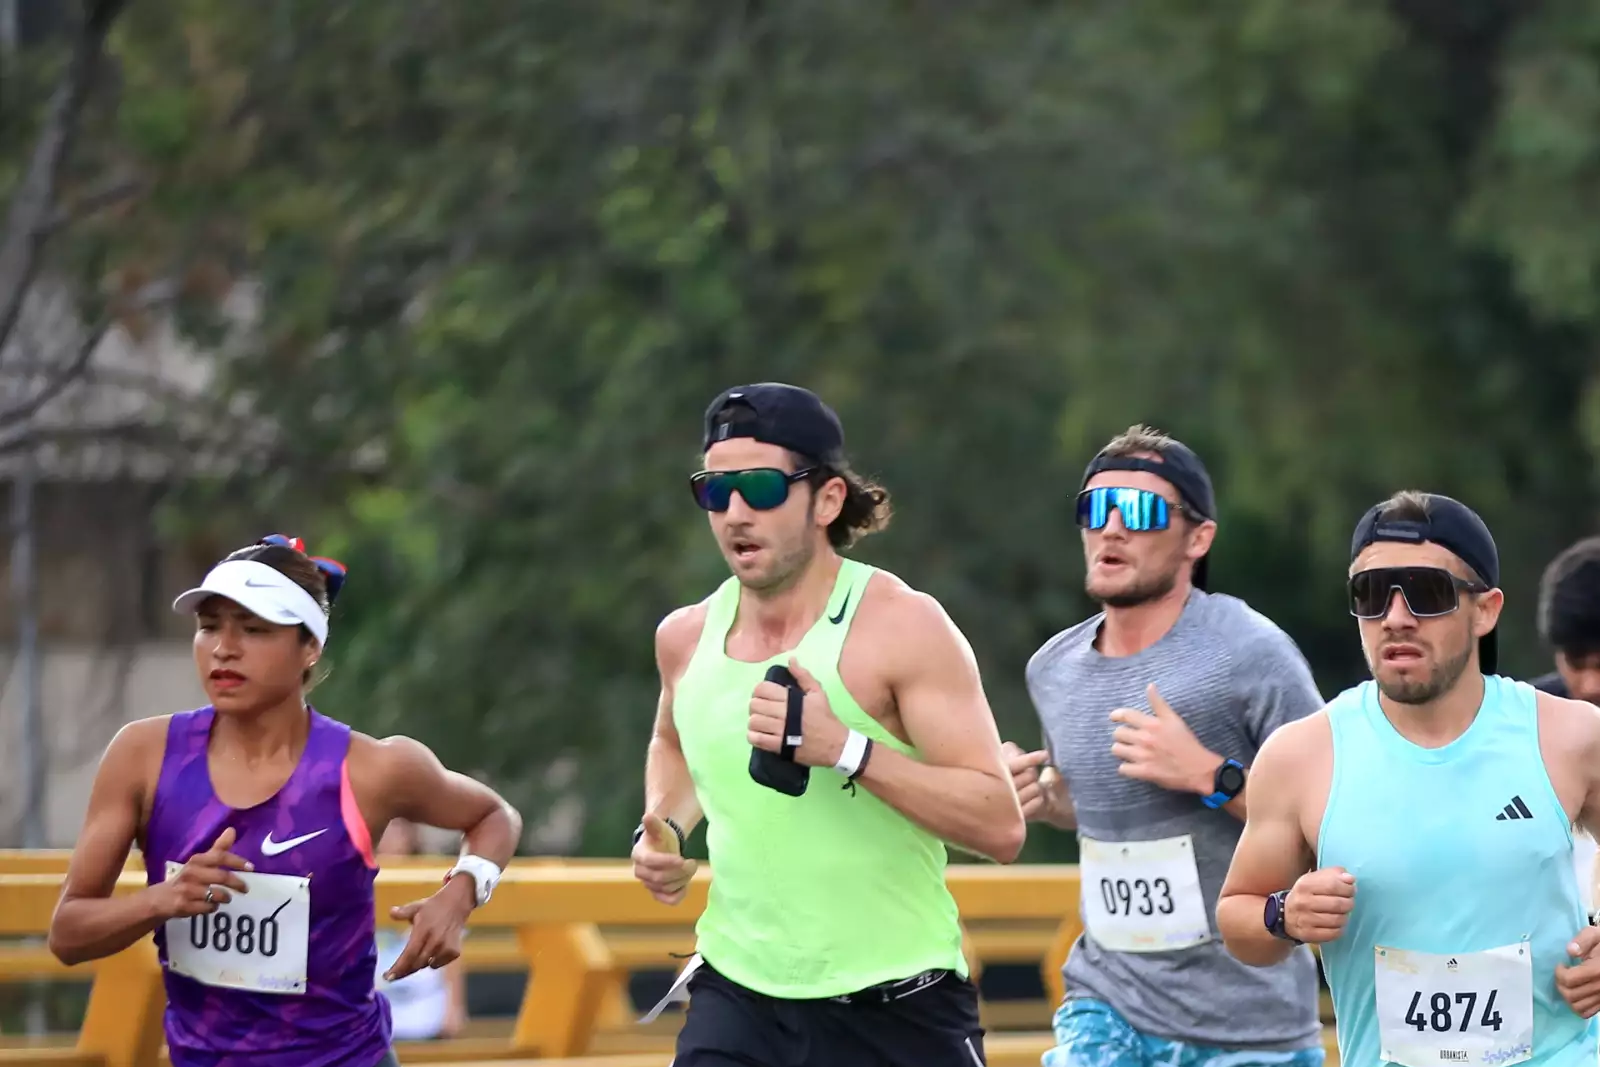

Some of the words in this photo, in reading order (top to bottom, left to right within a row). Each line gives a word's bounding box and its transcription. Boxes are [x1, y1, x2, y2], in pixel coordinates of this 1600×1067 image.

[1101, 878, 1174, 916] 0933
[190, 911, 279, 957] 0880
[1405, 990, 1503, 1032] 4874
